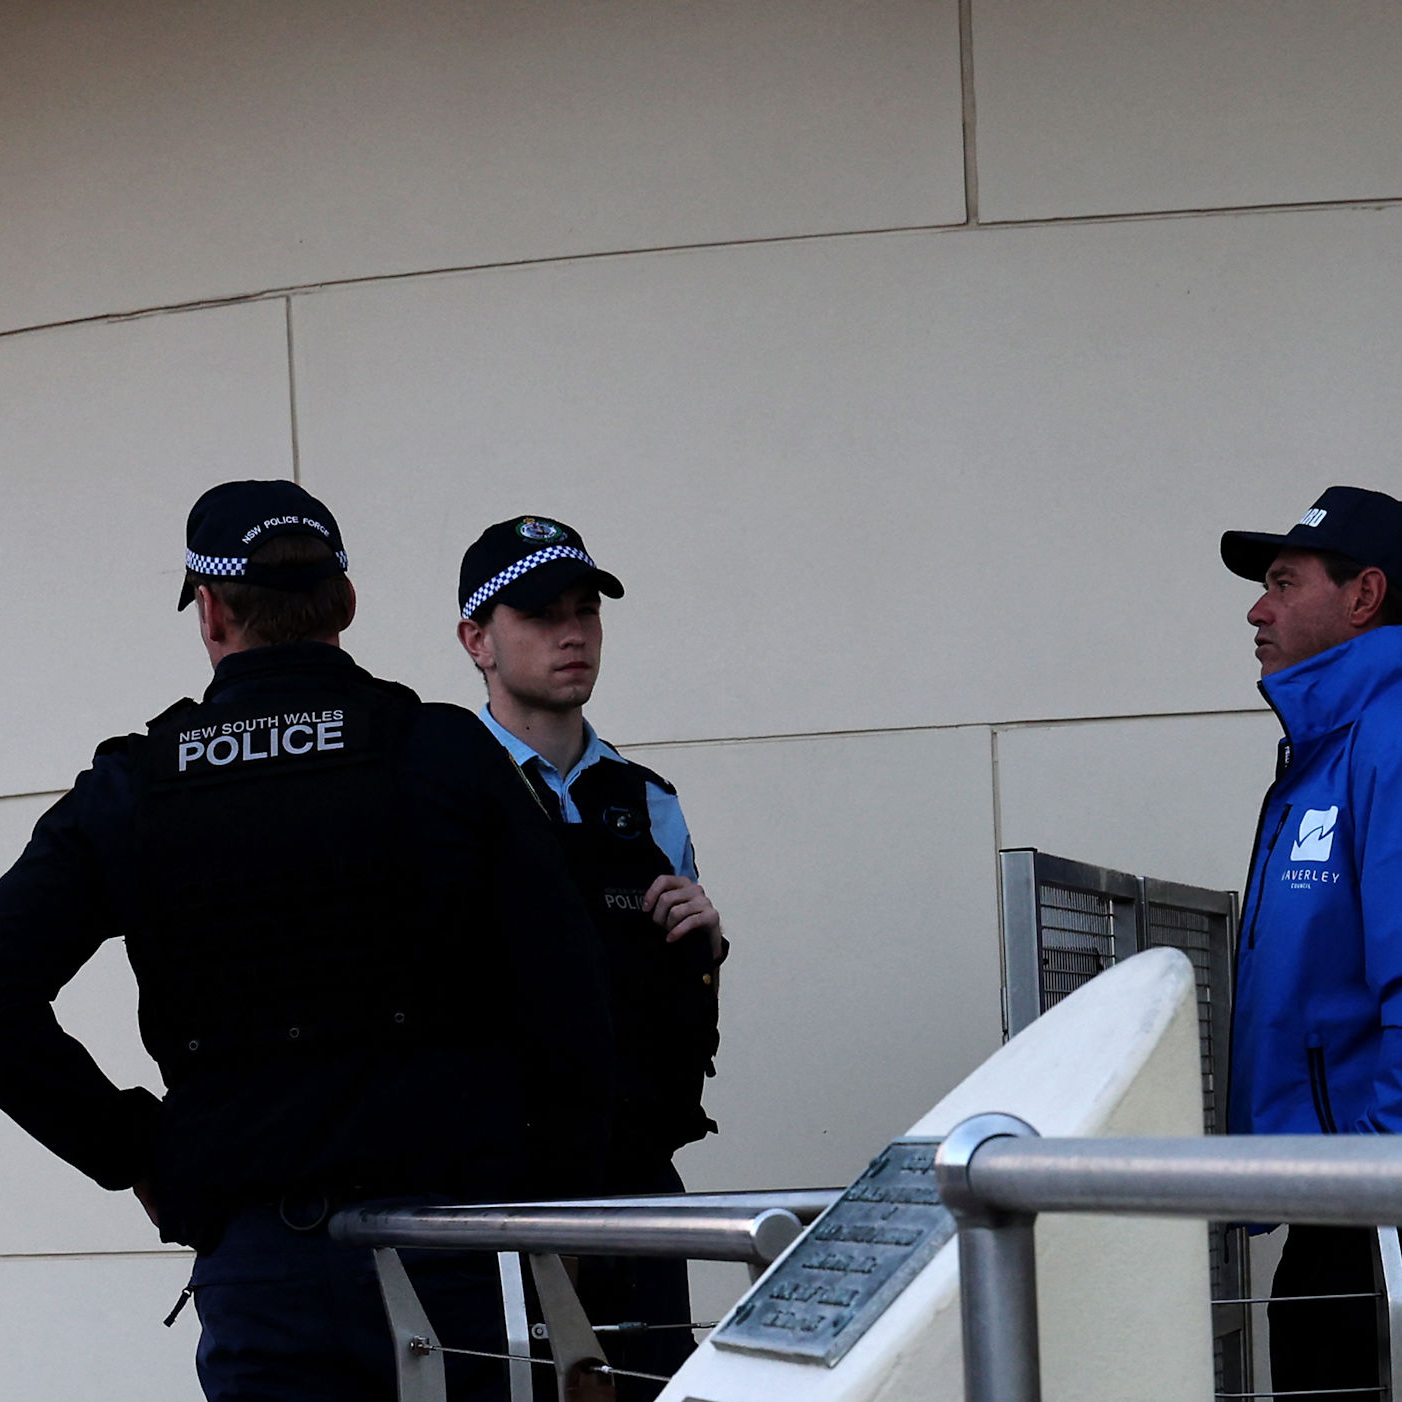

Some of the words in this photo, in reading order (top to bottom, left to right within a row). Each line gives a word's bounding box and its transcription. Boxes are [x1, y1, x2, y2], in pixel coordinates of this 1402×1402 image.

[241, 524, 262, 545] NSW
[263, 515, 300, 529] POLICE
[302, 517, 330, 537] FORCE
[179, 725, 217, 743] NEW
[221, 715, 279, 735] SOUTH
[284, 709, 344, 725] WALES
[178, 721, 345, 772] POLICE
